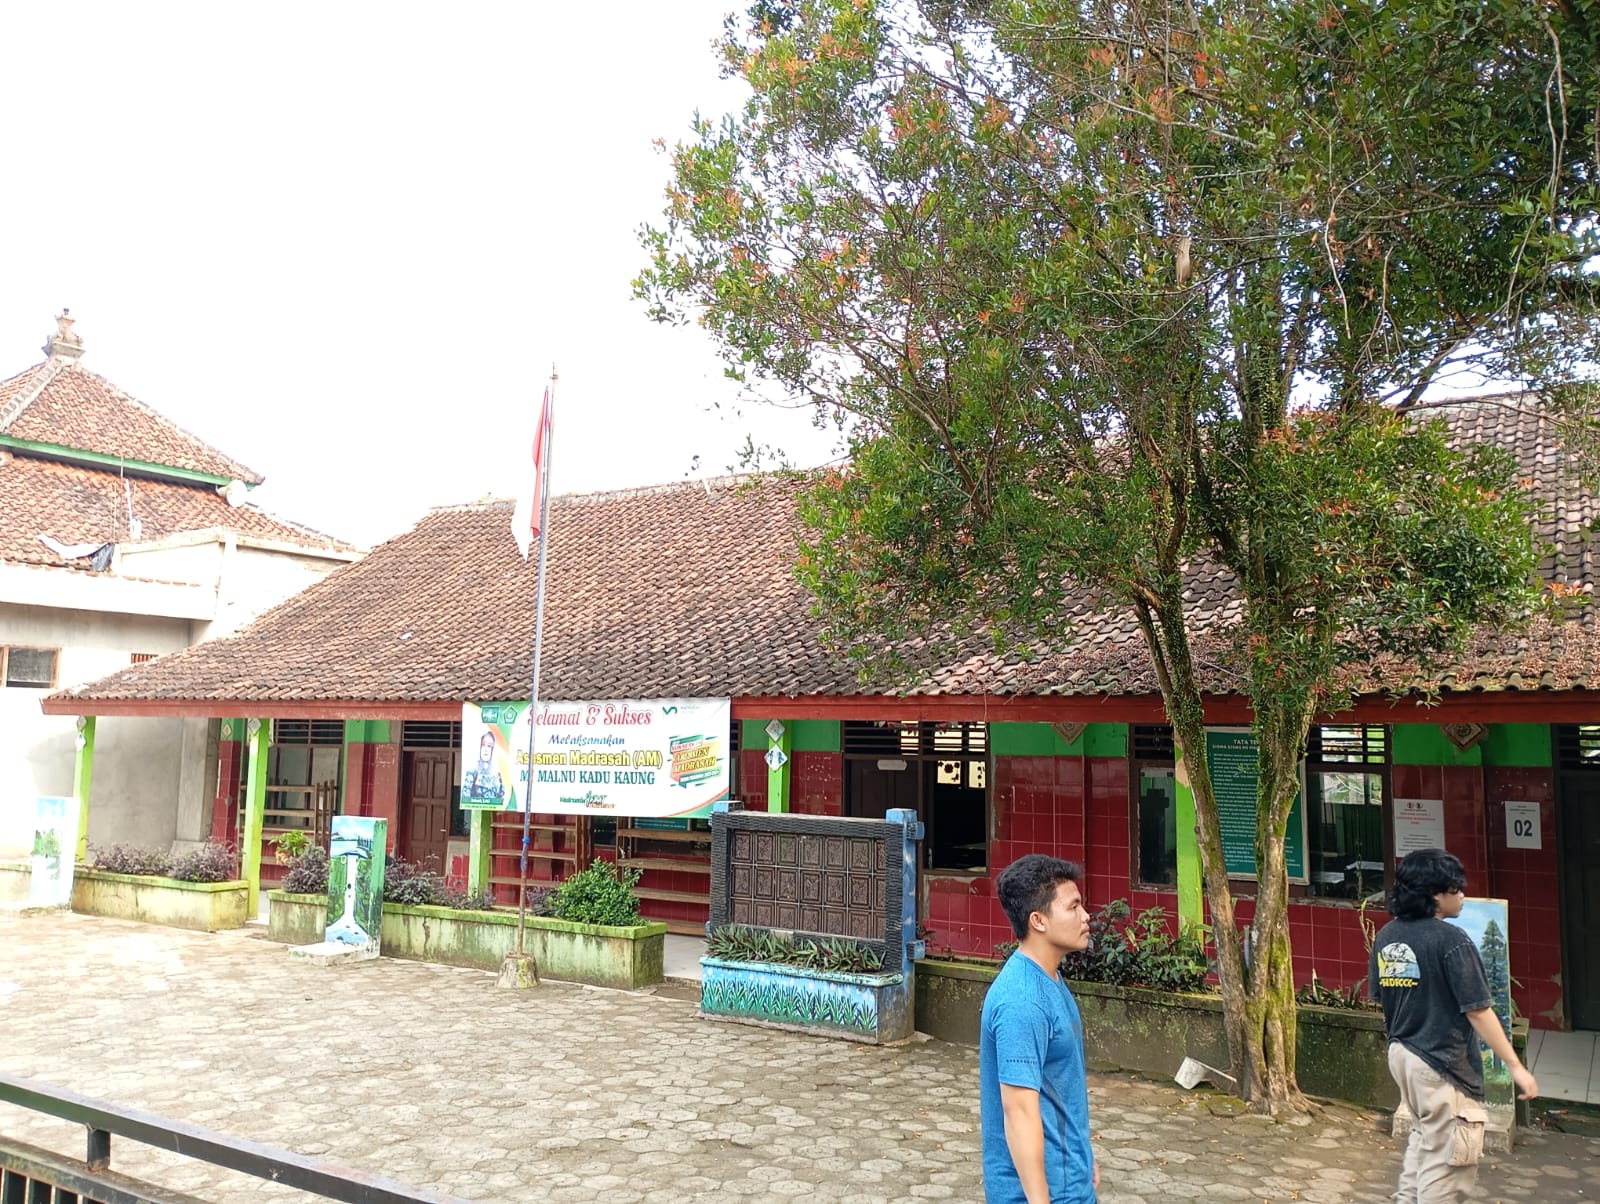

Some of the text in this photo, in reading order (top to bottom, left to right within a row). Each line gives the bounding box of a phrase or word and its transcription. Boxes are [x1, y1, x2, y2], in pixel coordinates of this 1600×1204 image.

[586, 704, 601, 726] &
[603, 704, 652, 726] Sukses
[548, 734, 625, 747] Melaksanakan
[569, 749, 631, 767] Madrasah
[633, 750, 663, 770] (AM)
[520, 770, 655, 785] M MALNU KADU KAUNG
[1514, 819, 1533, 837] 02
